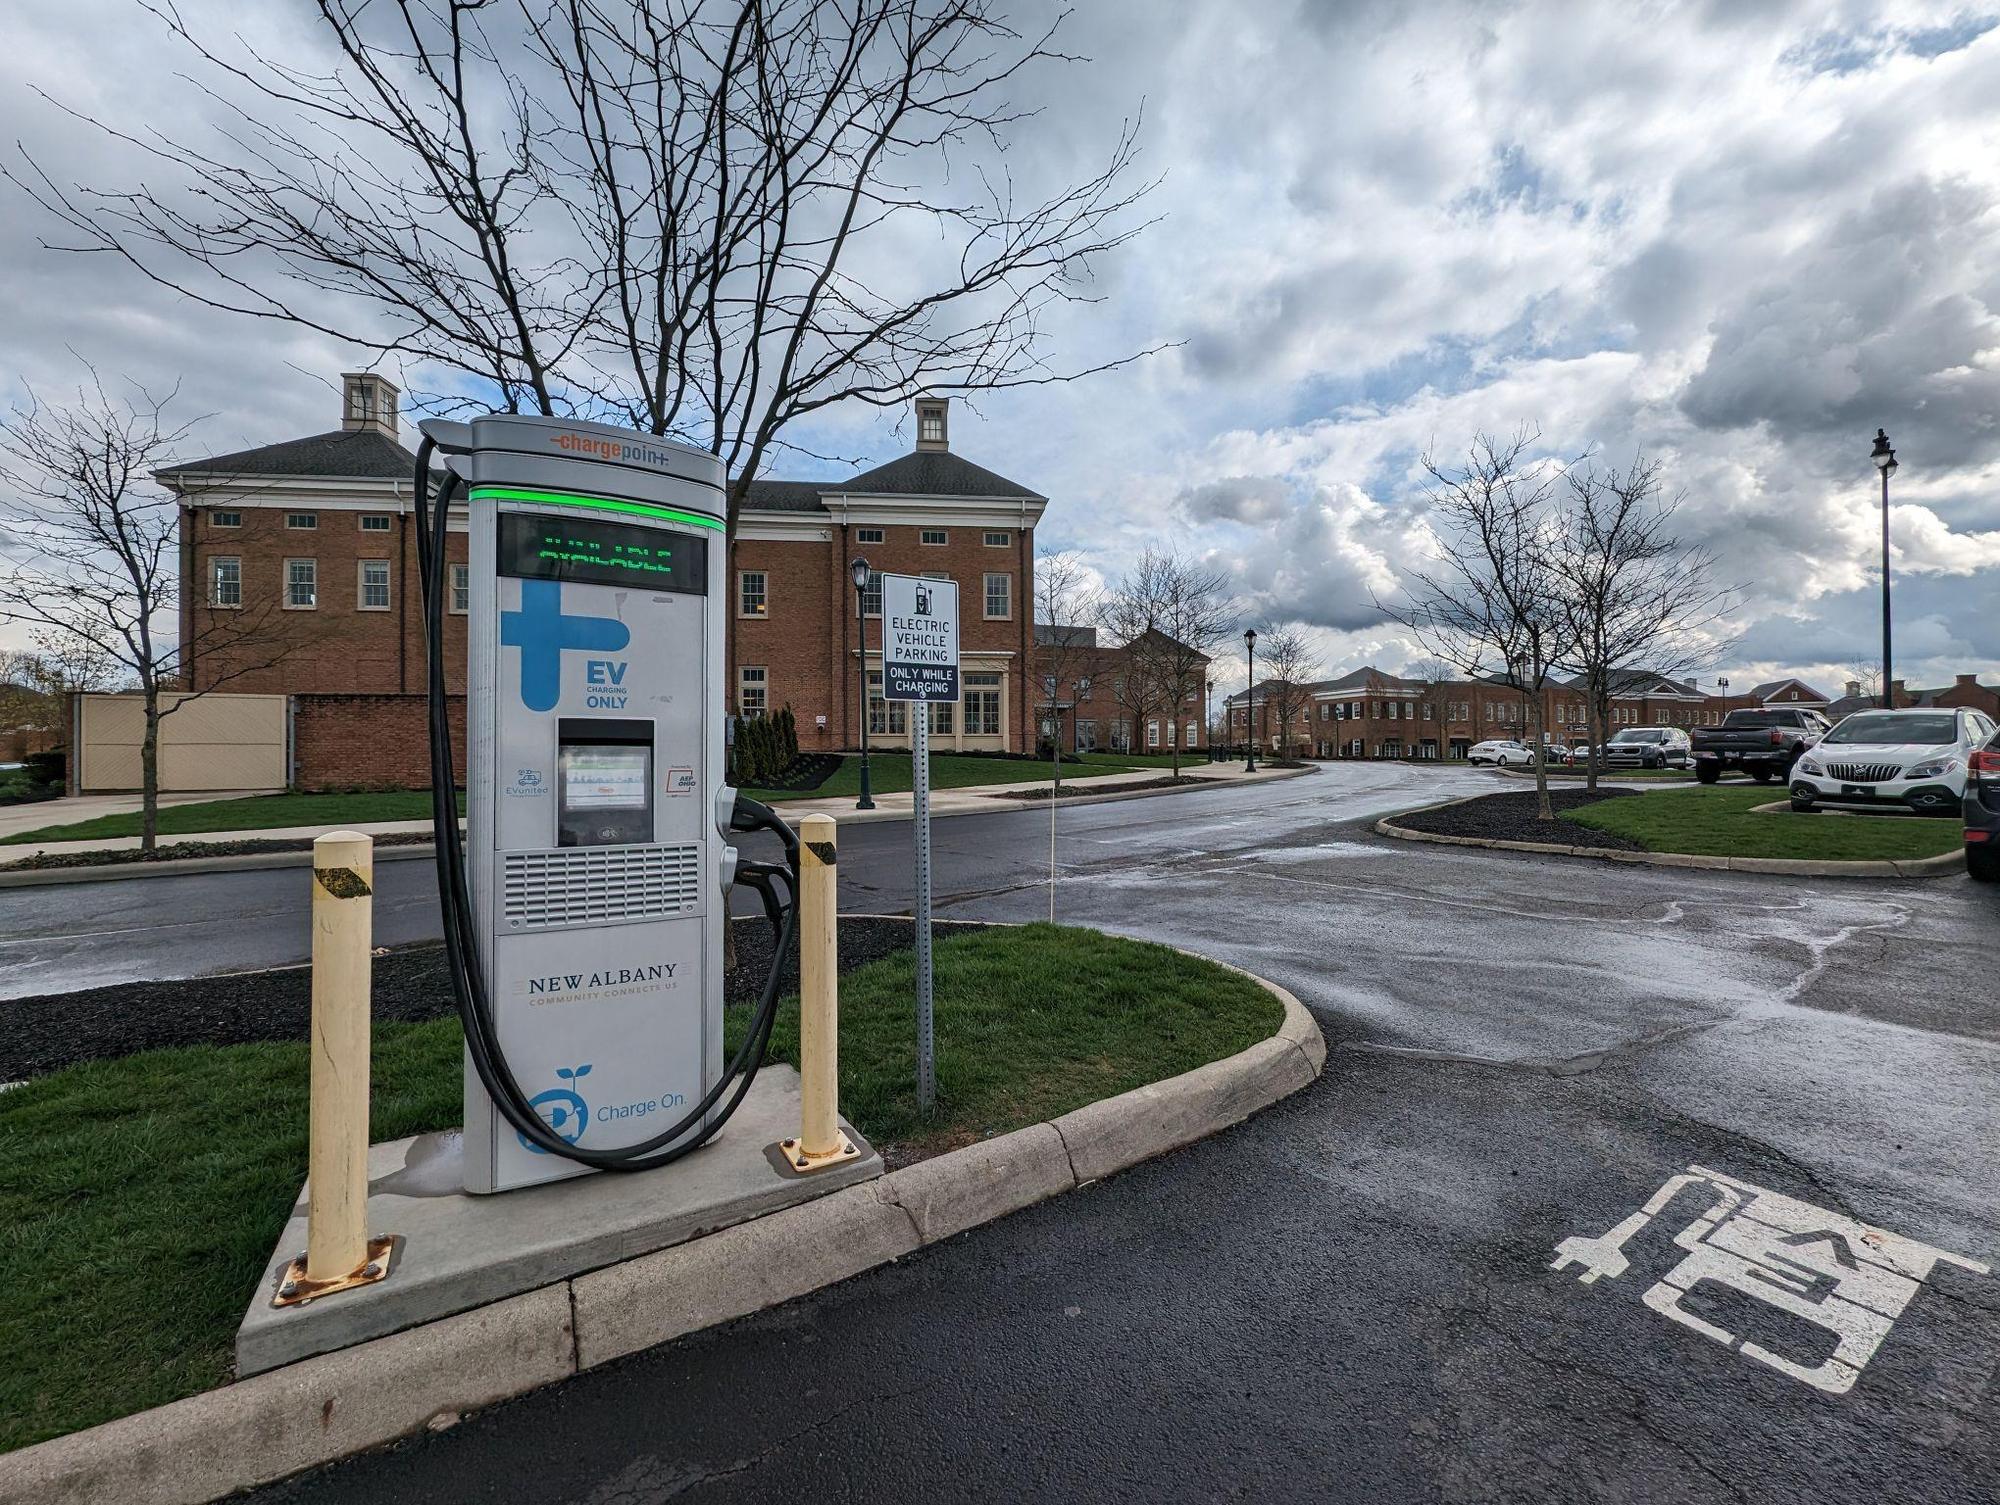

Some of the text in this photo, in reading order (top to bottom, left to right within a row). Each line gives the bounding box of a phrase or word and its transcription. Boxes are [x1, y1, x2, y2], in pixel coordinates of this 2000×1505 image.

[892, 617, 950, 633] ELECTRIC
[896, 632, 946, 647] VEHICLE
[895, 647, 948, 662] PARKING
[587, 660, 628, 685] EV
[890, 667, 953, 681] ONLY WHILE
[586, 686, 627, 695] CHARGING
[895, 680, 949, 693] CHARGING
[586, 695, 628, 709] ONLY
[528, 963, 678, 995] NEW ALBANY
[529, 992, 600, 1007] COMMUNITY
[597, 1092, 688, 1123] Charge On.
